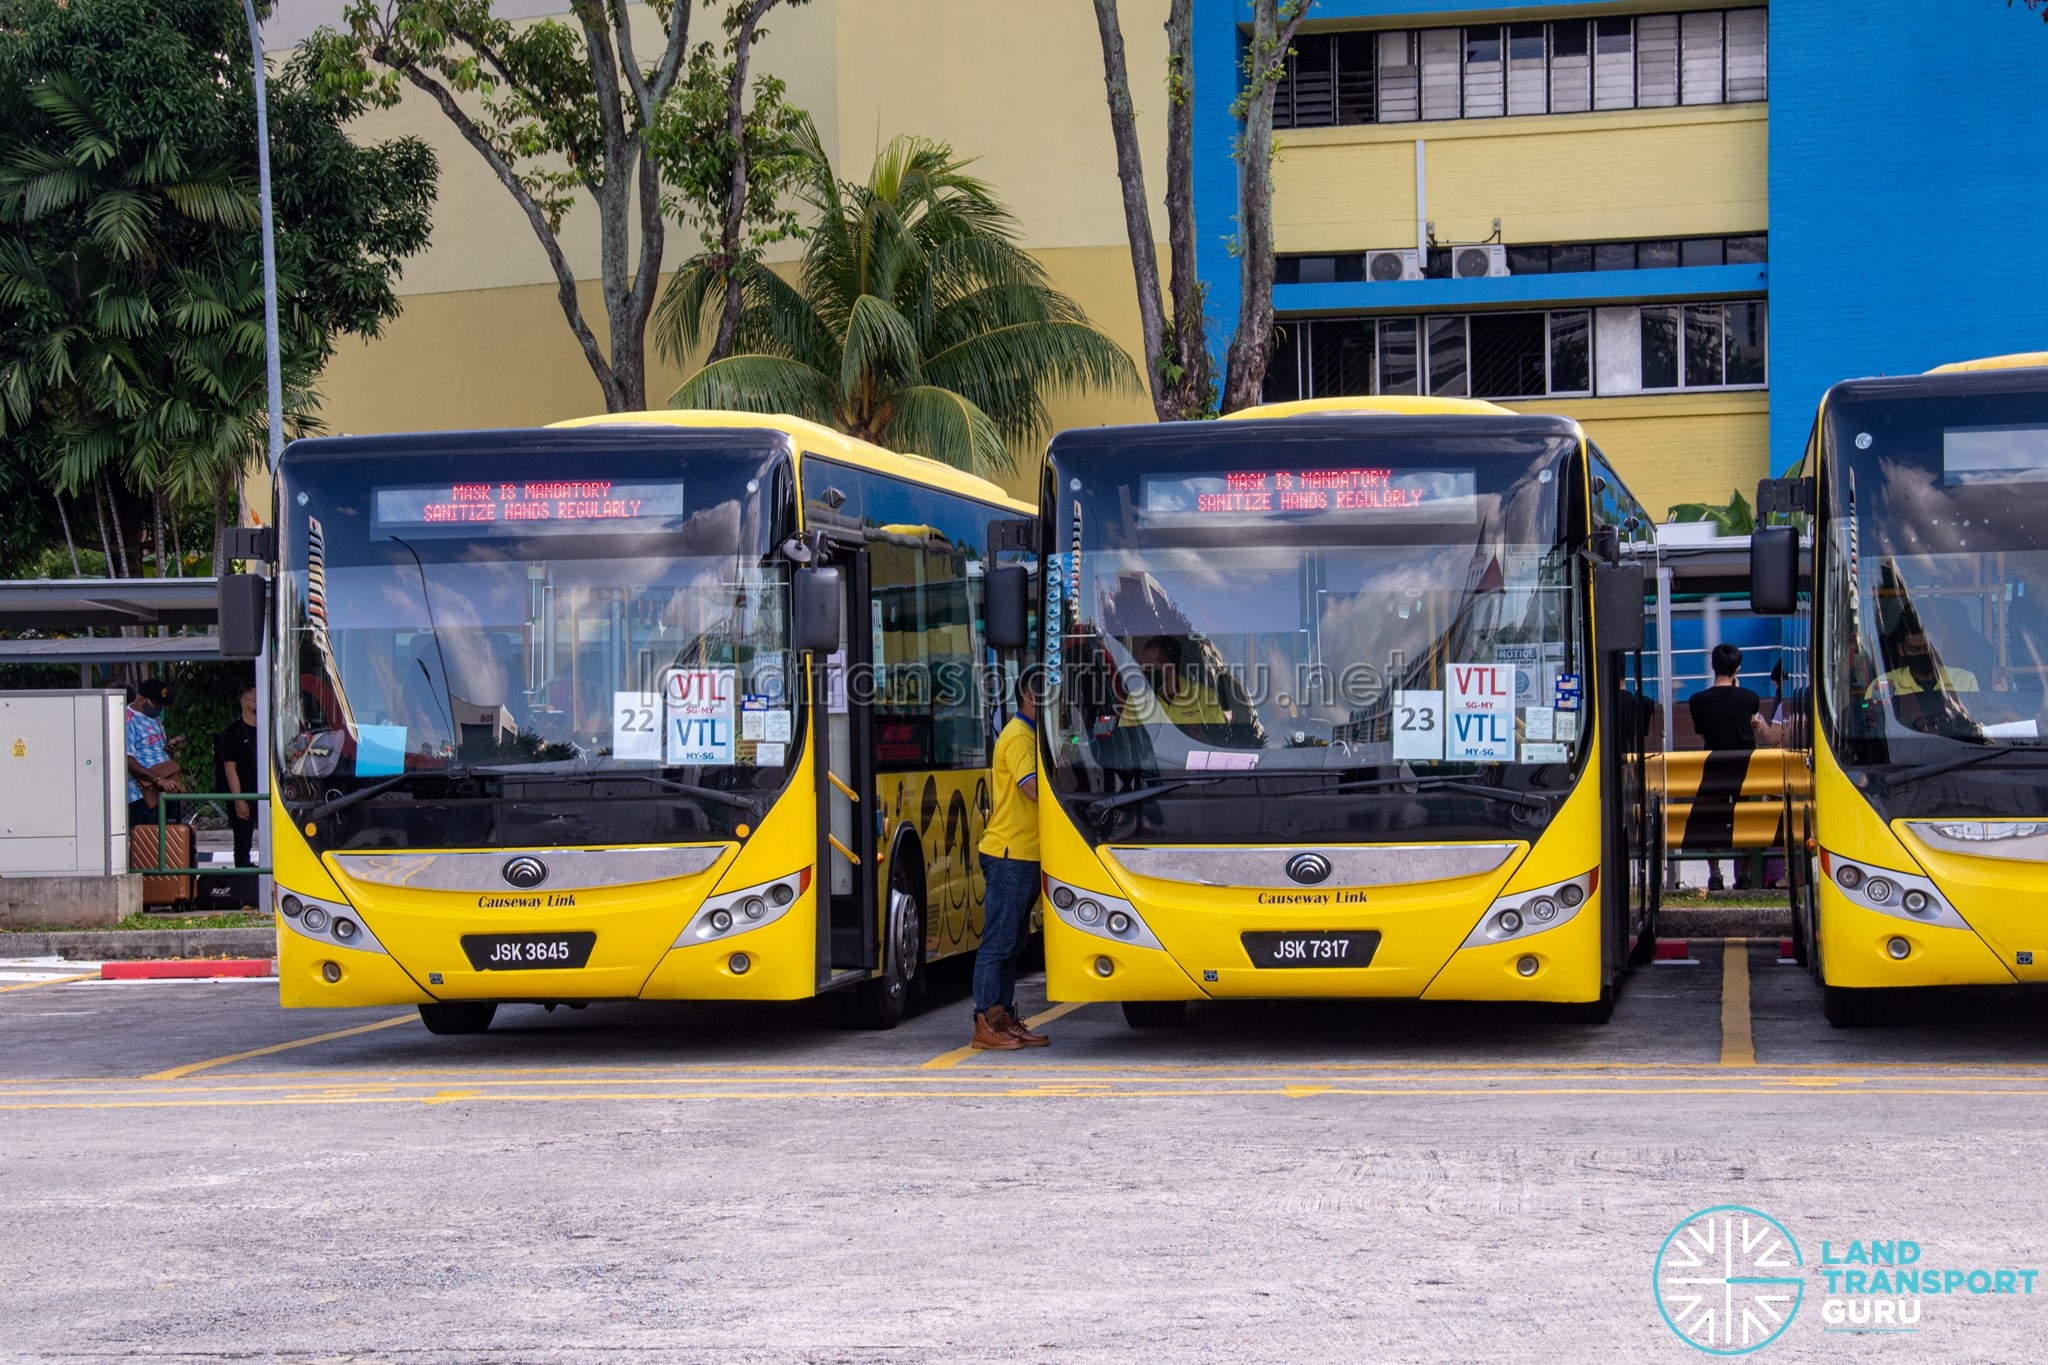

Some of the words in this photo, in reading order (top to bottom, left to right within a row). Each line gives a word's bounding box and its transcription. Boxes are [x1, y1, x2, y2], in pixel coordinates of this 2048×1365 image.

[1227, 474, 1266, 490] MASK
[1275, 473, 1292, 490] IS
[1301, 470, 1391, 489] MANDATORY
[453, 485, 491, 500] MASK
[499, 484, 516, 499] IS
[524, 482, 613, 499] MANDATORY
[1198, 493, 1272, 512] SANITIZE
[1280, 492, 1327, 510] HANDS
[1336, 489, 1423, 509] REGULARLY
[424, 503, 496, 522] SANITIZE
[504, 503, 549, 520] HANDS
[558, 500, 641, 519] REGULARLY
[1499, 649, 1535, 659] NOTICE
[676, 673, 726, 700] VTL
[1455, 667, 1506, 695] VTL
[620, 708, 654, 732] 22
[1400, 707, 1435, 732] 23
[1455, 714, 1506, 742] VTL
[676, 718, 726, 746] VTL
[686, 752, 714, 760] MY-SG
[1465, 748, 1494, 756] MY-SG
[478, 895, 544, 910] Causeway
[547, 894, 576, 907] Link
[1257, 892, 1331, 906] Causeway
[1335, 891, 1368, 903] Link
[490, 943, 522, 961] JSK
[525, 941, 569, 960] 3645
[1273, 940, 1307, 958] JSK
[1310, 939, 1349, 958] 7317
